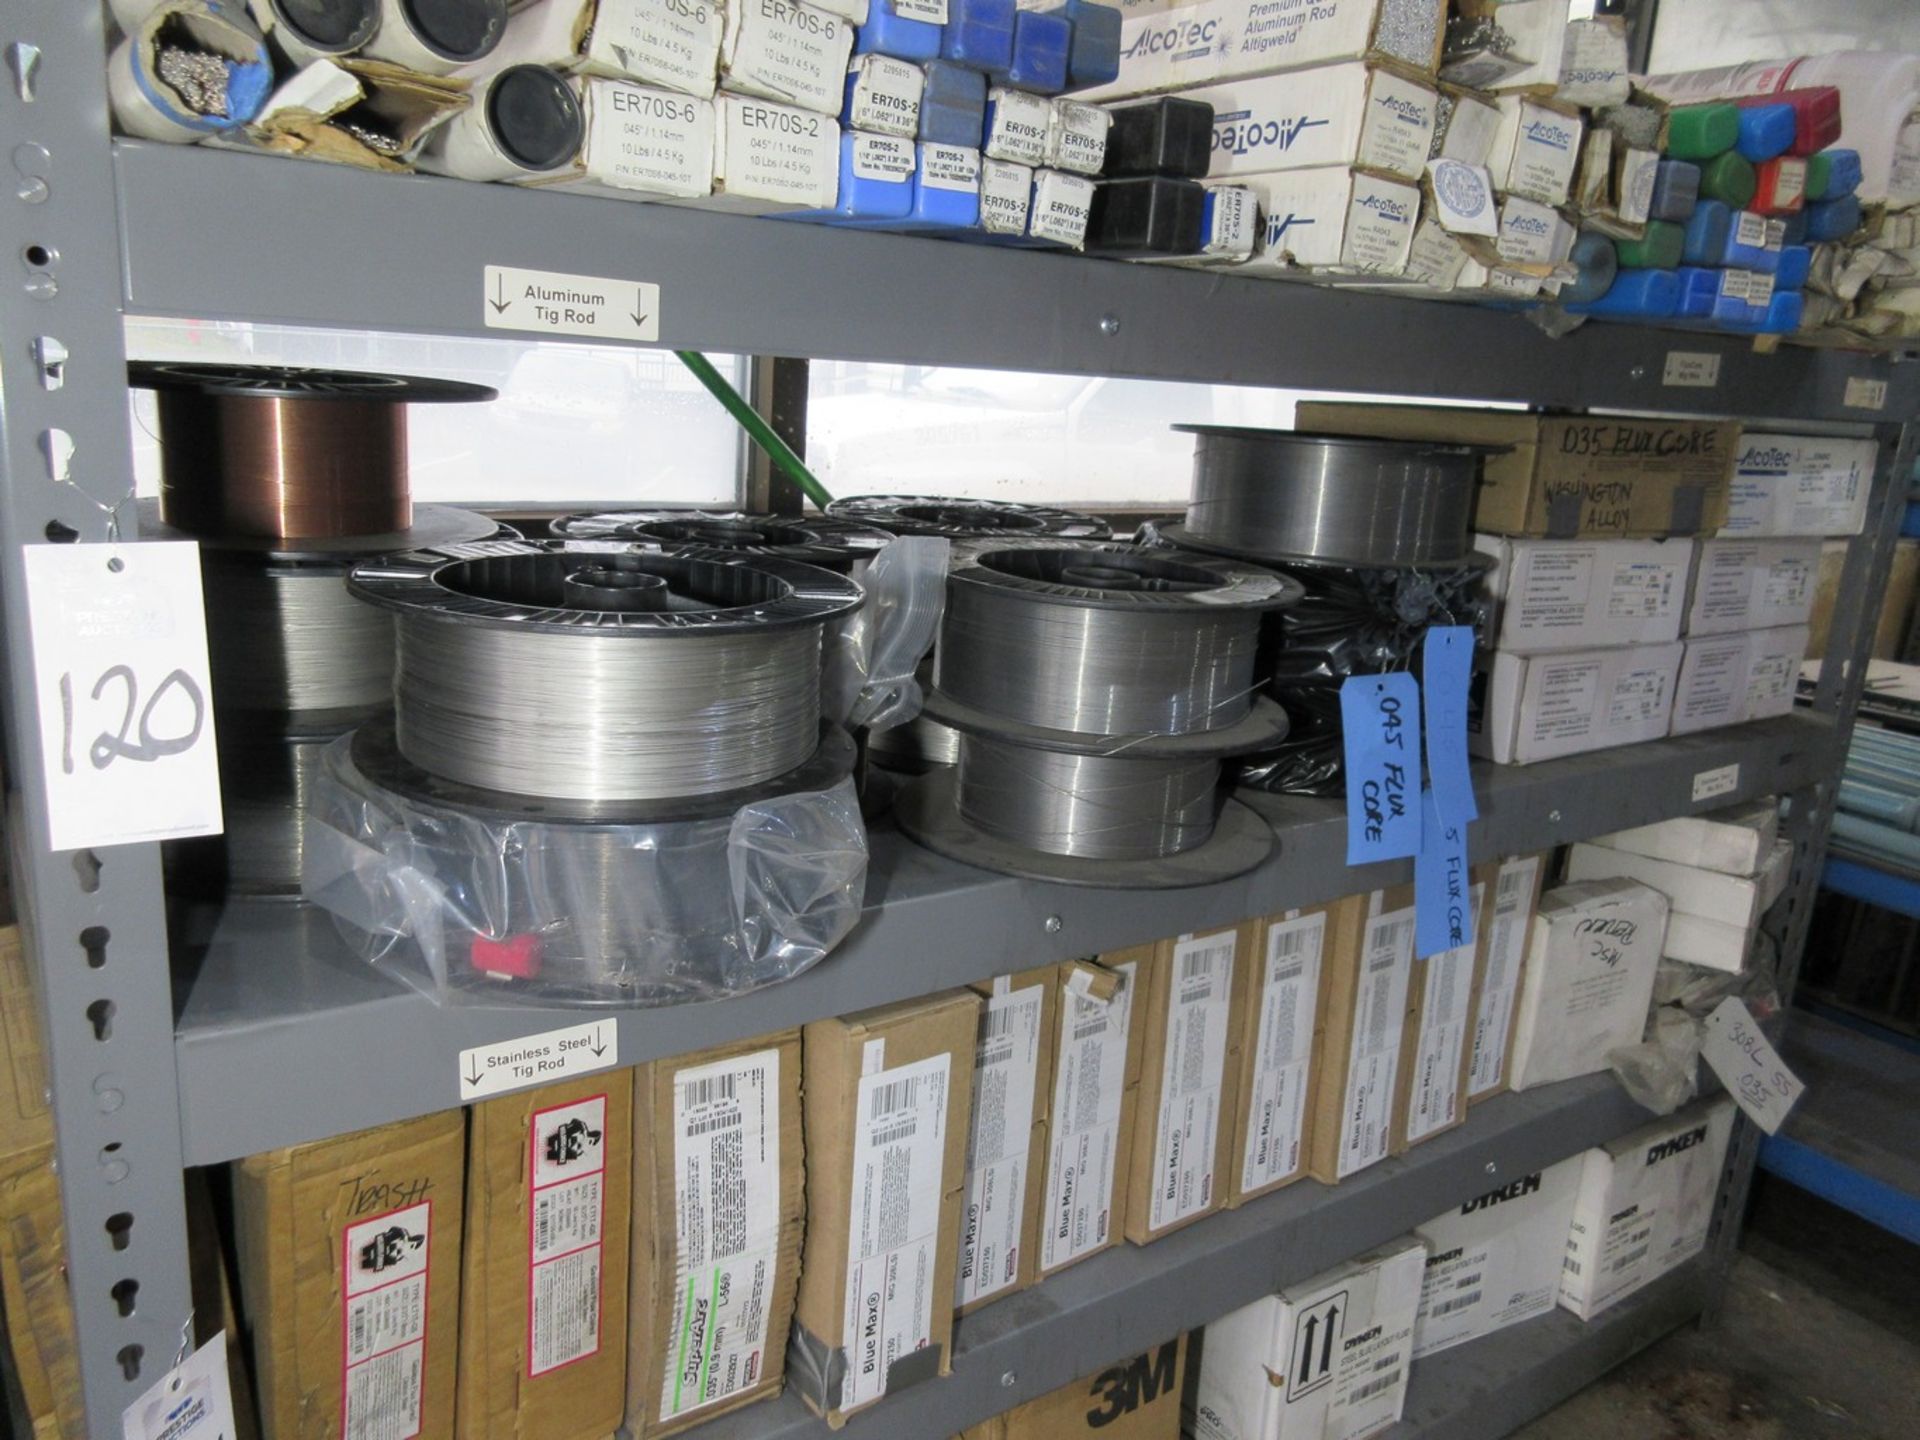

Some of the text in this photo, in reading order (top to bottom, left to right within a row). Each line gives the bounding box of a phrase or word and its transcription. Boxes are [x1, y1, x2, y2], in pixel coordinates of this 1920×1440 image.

[760, 0, 836, 41] ER70S-6
[1244, 3, 1337, 36] Aluminum Rod
[1120, 17, 1223, 60] AlcoTec
[1240, 29, 1297, 53] Altigweld
[775, 51, 790, 67] Lbs
[809, 61, 820, 79] Kg
[613, 90, 696, 123] ER70S-6
[871, 92, 919, 115] ER70S-2
[1374, 94, 1424, 119] AlcoTec
[742, 106, 819, 138] ER70S-2
[1005, 120, 1047, 141] ER70S-2
[1522, 120, 1571, 146] AlcoTec
[621, 143, 633, 155] 10
[634, 144, 650, 158] Lbs
[671, 150, 685, 165] Kg
[869, 140, 900, 153] ER70S-2
[1065, 133, 1105, 152] ER70S-2
[750, 155, 761, 167] 10
[762, 157, 777, 169] Lbs
[799, 162, 811, 176] Kg
[936, 150, 965, 163] ER70S-2
[984, 194, 1027, 214] ER70S-2
[1050, 200, 1089, 221] ER70S-2
[1231, 191, 1243, 240] ER70S-2
[1355, 194, 1408, 216] AlcoTec
[1503, 213, 1549, 234] AlcoTec
[524, 284, 606, 307] Aluminum
[535, 305, 596, 325] Tig Rod
[1653, 426, 1718, 457] CORE
[1735, 447, 1793, 468] AlcoTec
[1543, 477, 1633, 507] WASHINGTON
[1586, 508, 1632, 530] ALLOY
[59, 664, 205, 775] 120
[1383, 761, 1407, 823] FLUX
[1361, 779, 1383, 845] CORE
[1446, 857, 1465, 949] FLUX CORE
[487, 1035, 592, 1069] Stainless Steel
[512, 1056, 566, 1079] Tig Rod
[1419, 1089, 1430, 1115] Blue
[1351, 1123, 1362, 1150] Blue
[1645, 1124, 1708, 1168] DYKEM
[1257, 1137, 1269, 1166] Blue
[1166, 1170, 1178, 1200] Blue
[1461, 1172, 1542, 1216] DYKEM
[1059, 1207, 1070, 1238] Blue
[961, 1247, 975, 1279] Blue
[1426, 1247, 1464, 1268] DYKEM
[682, 1298, 708, 1388] SuperArc
[713, 1326, 727, 1351] mm)
[1344, 1325, 1383, 1351] DYKEM
[863, 1339, 879, 1374] Blue
[1086, 1338, 1179, 1429] 3M
[168, 1409, 206, 1440] CTIONS
